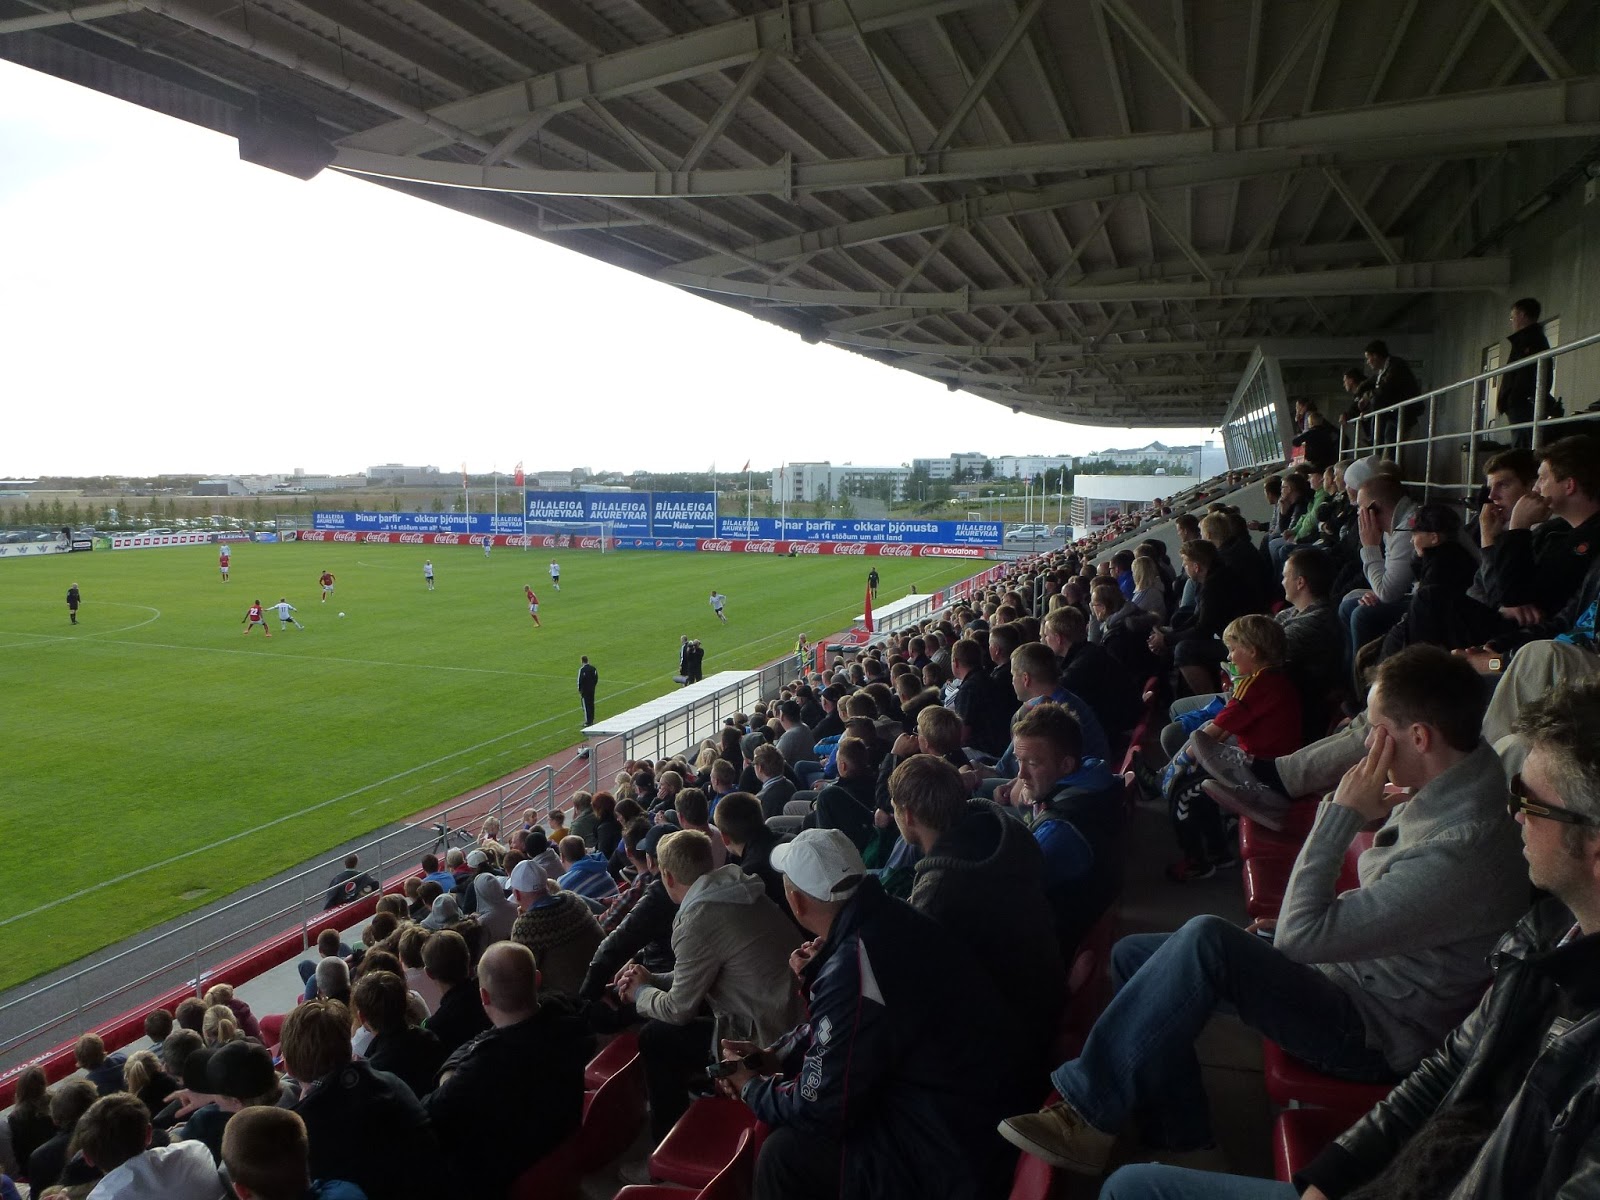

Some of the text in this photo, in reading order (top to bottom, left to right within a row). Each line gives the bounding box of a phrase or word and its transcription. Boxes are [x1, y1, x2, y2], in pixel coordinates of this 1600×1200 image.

[530, 500, 582, 509] BÍLALEIGA
[591, 500, 646, 511] BÍLALEIGA
[656, 501, 712, 511] BÍLALEIGA
[529, 509, 584, 518] AKUREYRAR
[590, 511, 647, 520] AKUREYRAR
[654, 511, 714, 520] AKUREYRAR
[356, 514, 376, 522] Þinar
[379, 514, 402, 523] þarfir
[441, 515, 478, 524] þjónusta
[806, 521, 836, 531] þarfir
[854, 522, 885, 531] okkar
[888, 522, 938, 533] þjónusta
[943, 547, 979, 555] vodafone
